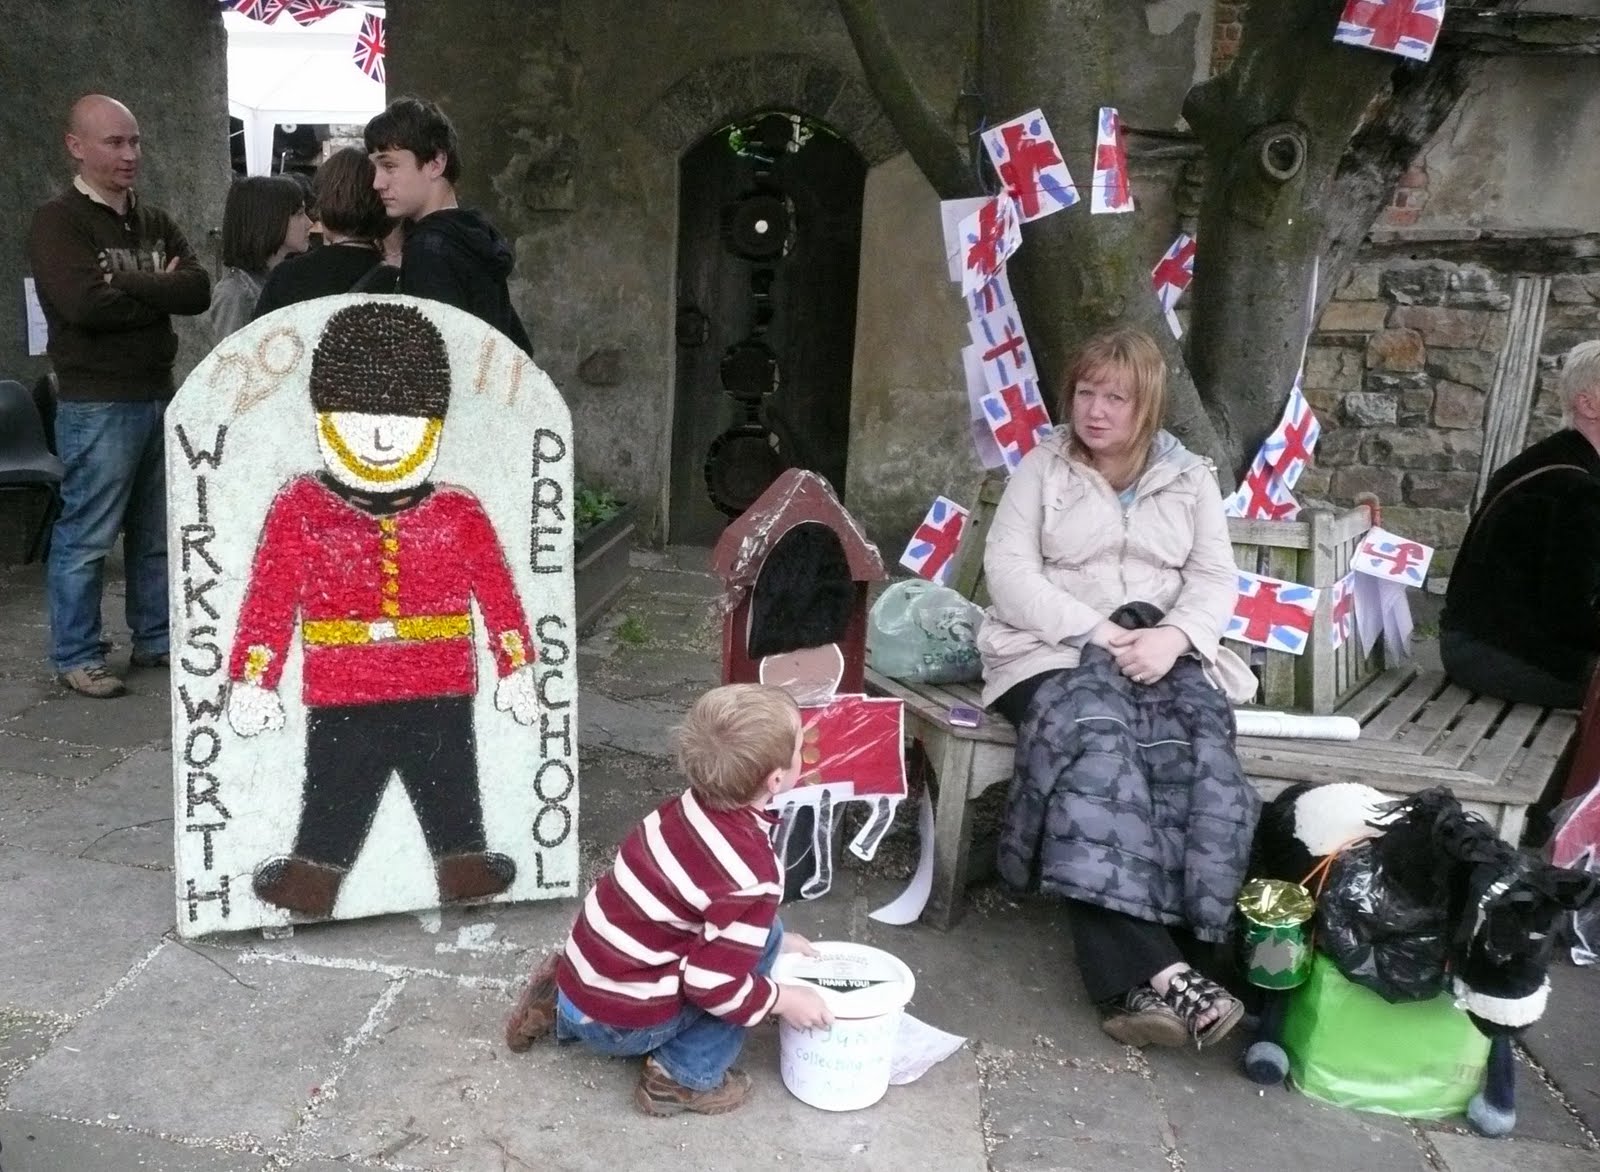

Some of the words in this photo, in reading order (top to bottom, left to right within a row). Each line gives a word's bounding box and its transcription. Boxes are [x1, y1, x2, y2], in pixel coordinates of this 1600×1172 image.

[531, 429, 566, 574] PRE
[175, 424, 232, 922] WIRKSWORTH
[534, 616, 575, 890] SCHOOL
[818, 978, 848, 987] THANK
